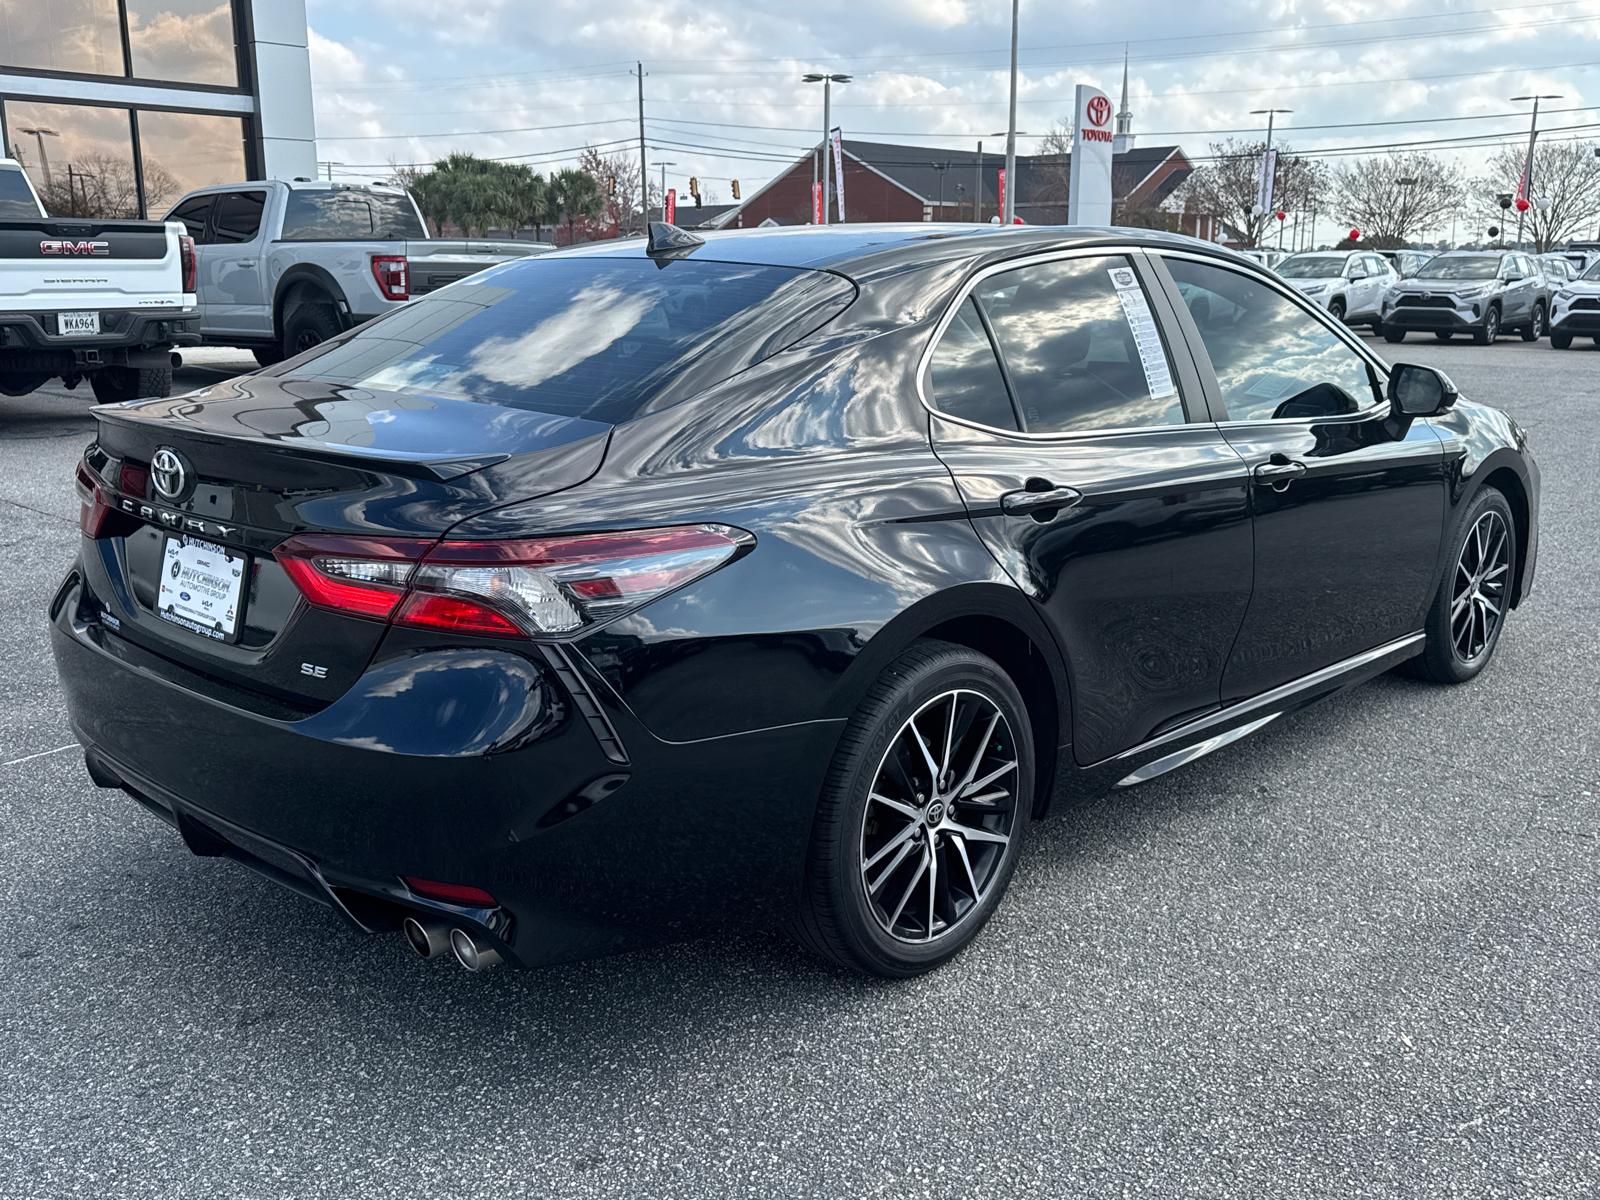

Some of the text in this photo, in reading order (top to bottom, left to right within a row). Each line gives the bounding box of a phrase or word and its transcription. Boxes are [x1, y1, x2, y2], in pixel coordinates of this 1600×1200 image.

[1081, 128, 1113, 143] TOYOTA
[39, 240, 110, 255] GMC
[63, 318, 95, 330] WKA964
[122, 499, 237, 537] CAMRY
[188, 536, 226, 555] HUTCHINSON
[196, 559, 211, 568] GMC
[180, 566, 232, 593] HUTCHINSON
[180, 579, 227, 601] AUTOMOTIVE GROUP
[300, 662, 329, 679] SE
